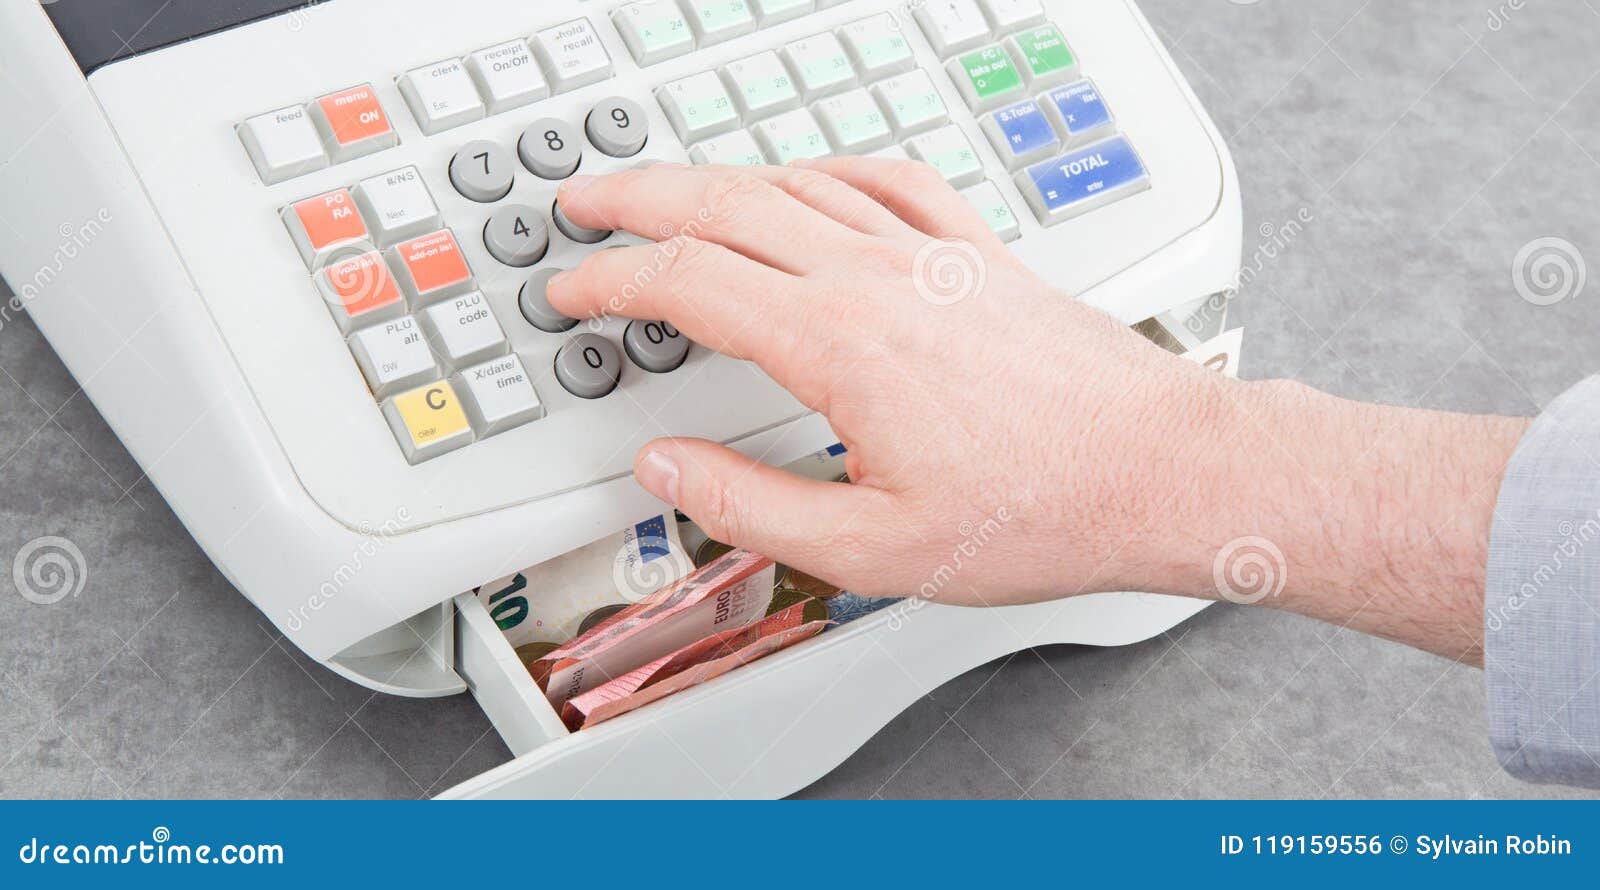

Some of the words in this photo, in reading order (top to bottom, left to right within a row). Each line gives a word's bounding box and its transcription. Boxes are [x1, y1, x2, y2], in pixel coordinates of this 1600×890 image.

[484, 43, 524, 61] receipt
[562, 35, 594, 52] recall
[431, 61, 461, 78] clerk
[492, 55, 529, 73] On/Off
[335, 90, 369, 106] menu
[275, 109, 303, 124] feed
[359, 109, 380, 124] ON
[610, 107, 630, 129] 9
[1000, 103, 1037, 122] S.Total
[543, 130, 564, 152] 8
[473, 151, 490, 175] 7
[1059, 153, 1110, 179] TOTAL
[386, 171, 415, 187] #/NS
[325, 193, 345, 207] PO
[332, 206, 353, 220] RA
[512, 216, 530, 238] 4
[412, 234, 449, 250] discount
[409, 248, 439, 262] add-on
[439, 242, 454, 255] list
[455, 296, 481, 311] PLU
[459, 309, 489, 326] code
[386, 320, 412, 335] PLU
[404, 333, 420, 346] alt
[583, 346, 603, 369] 0
[474, 359, 516, 381] X/date/
[496, 372, 523, 389] time
[425, 388, 447, 411] C
[488, 572, 529, 632] 10
[713, 590, 731, 625] EURO
